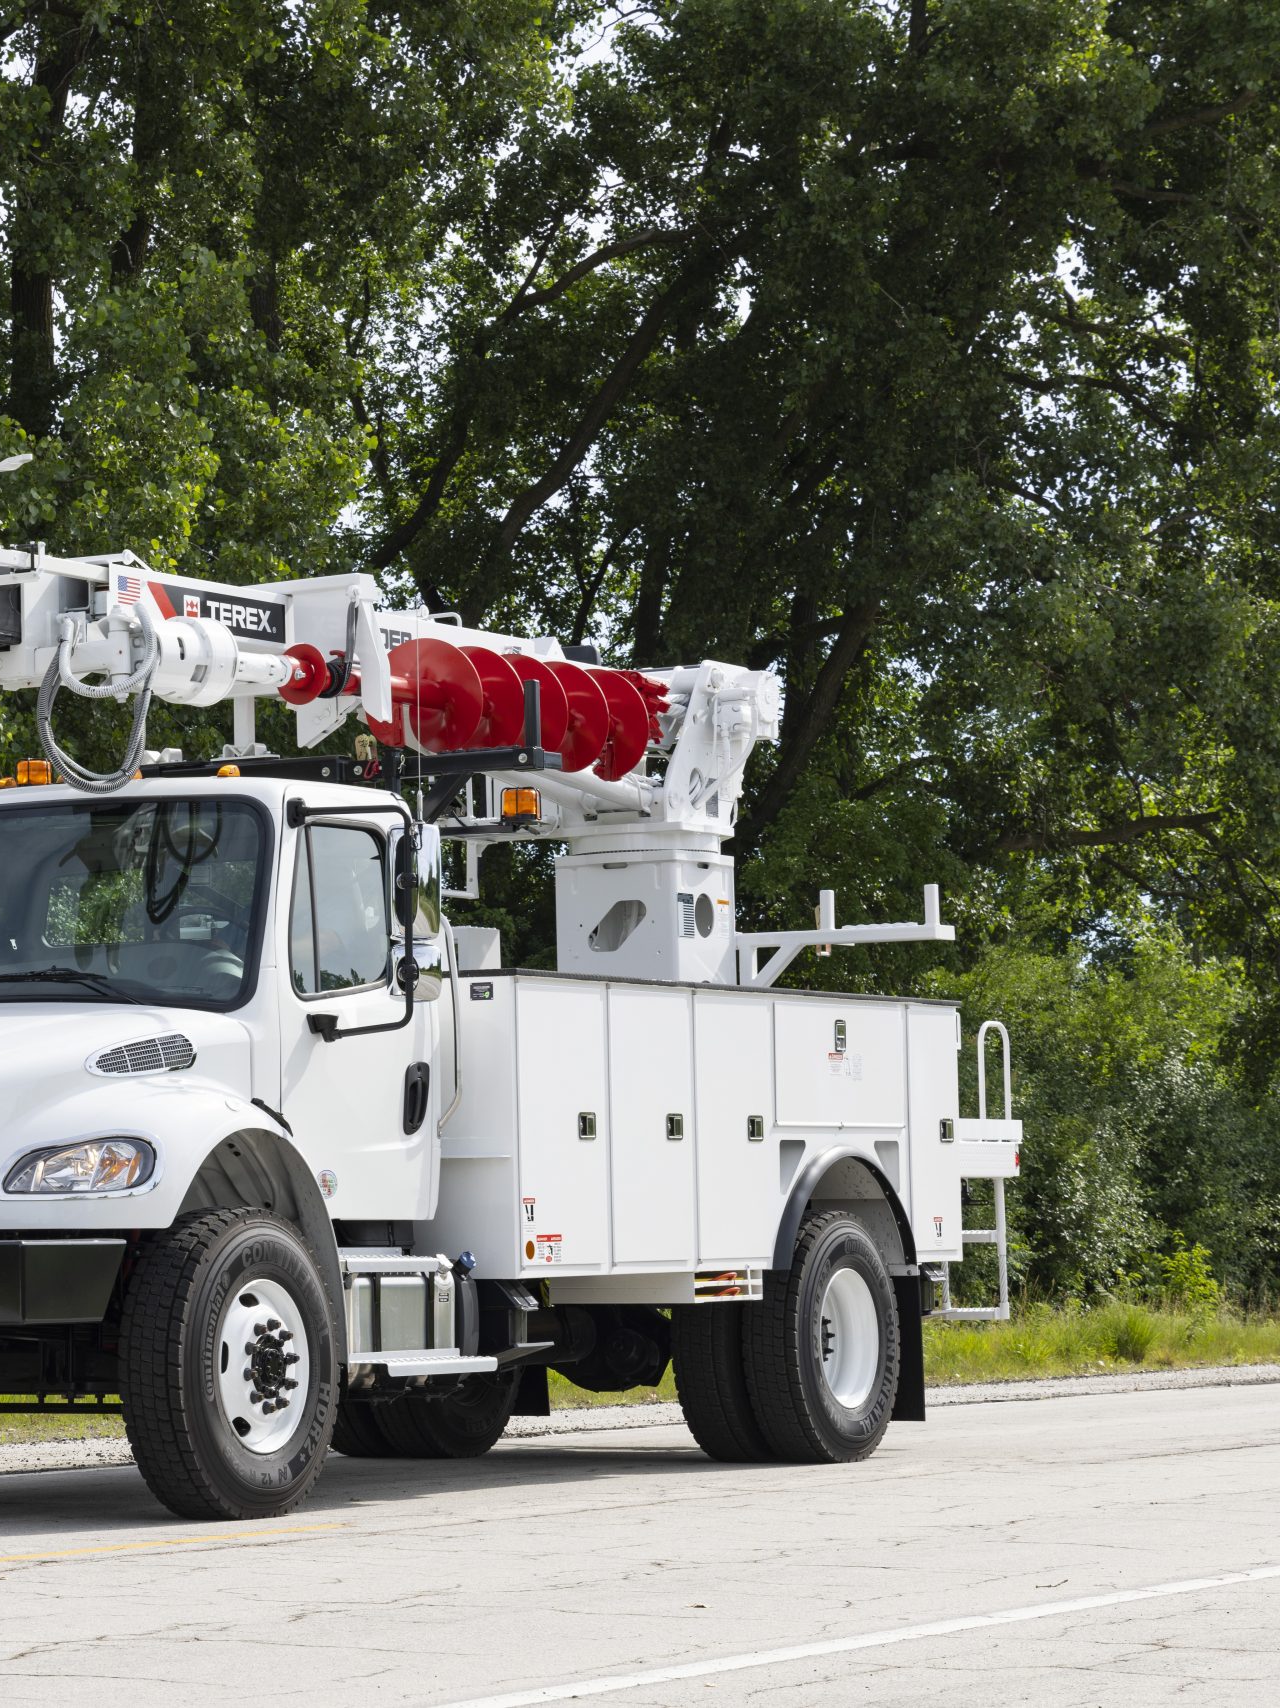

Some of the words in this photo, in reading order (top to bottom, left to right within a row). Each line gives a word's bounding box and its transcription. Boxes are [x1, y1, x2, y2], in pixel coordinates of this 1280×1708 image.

[206, 600, 271, 633] TEREX
[241, 1239, 329, 1342] CONTINEL
[859, 1308, 897, 1435] CONTINENTAL
[299, 1382, 331, 1462] HDR2+
